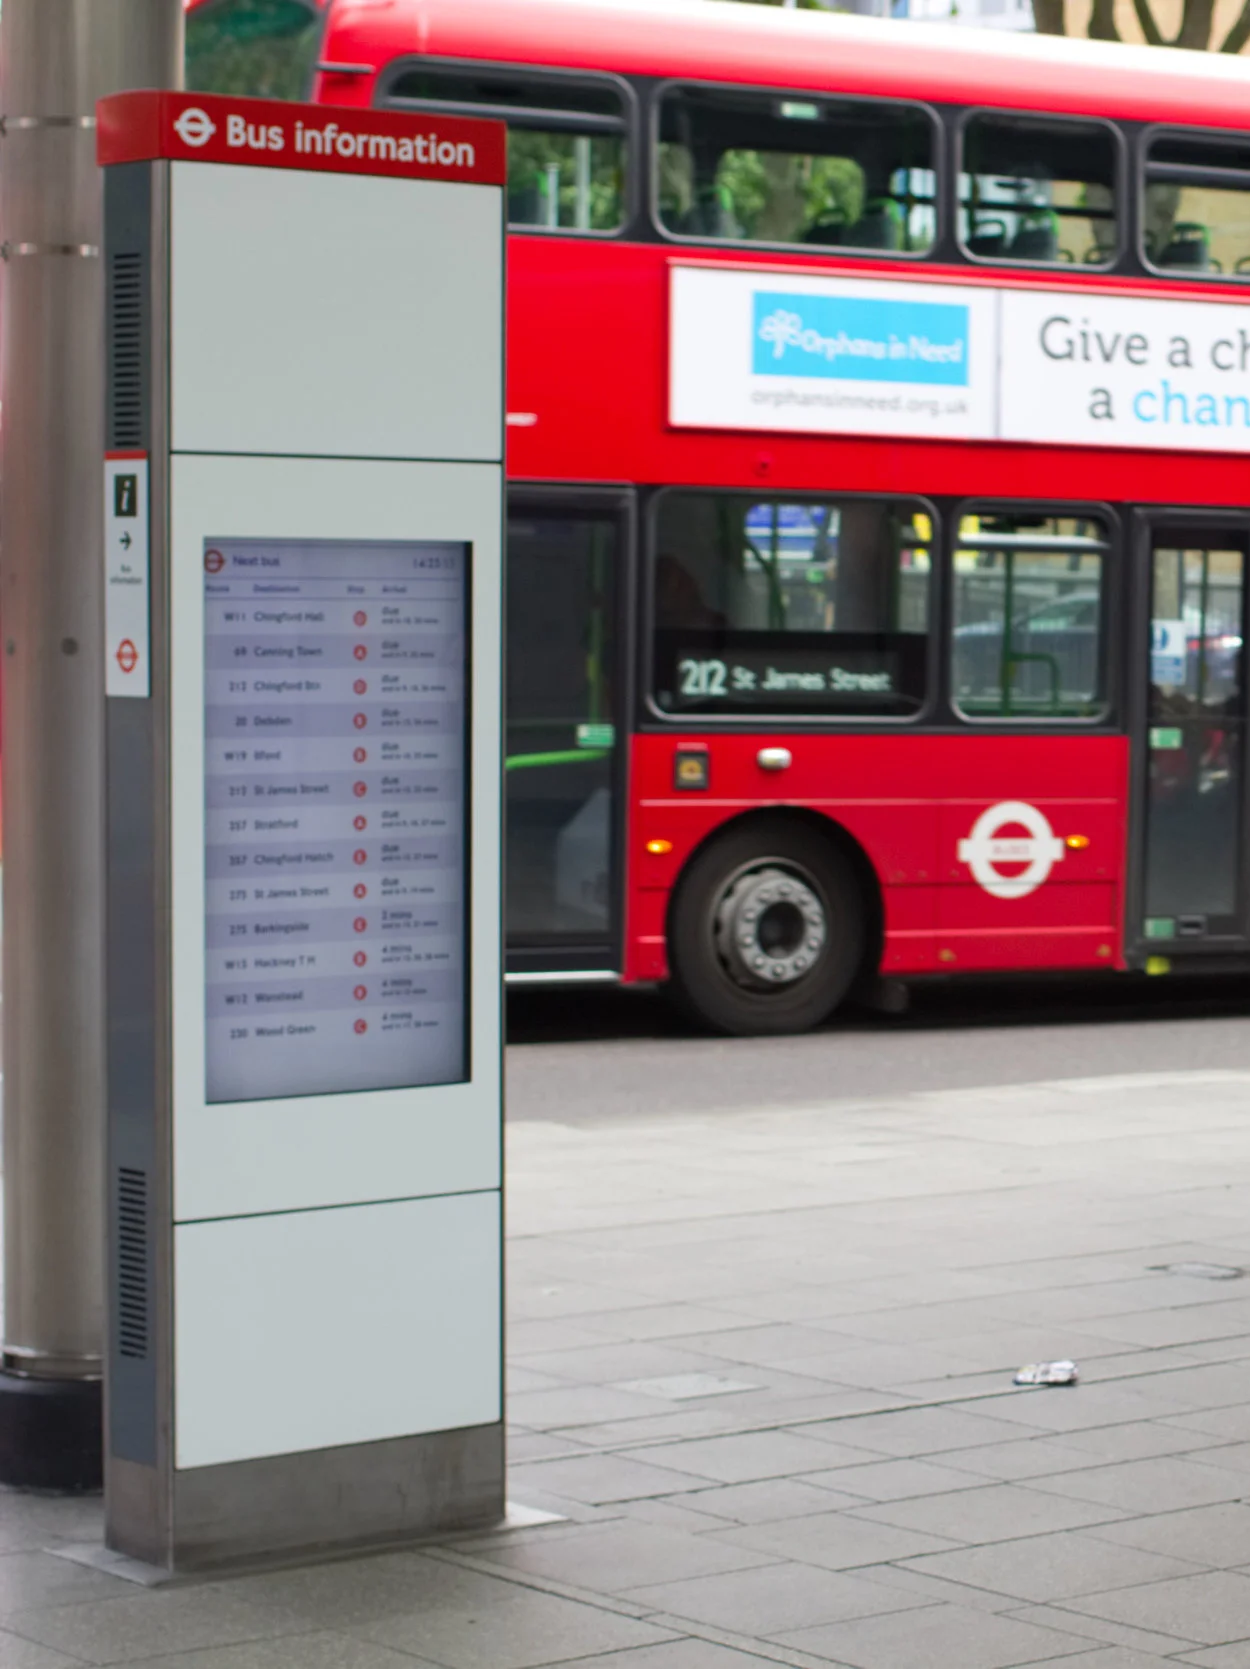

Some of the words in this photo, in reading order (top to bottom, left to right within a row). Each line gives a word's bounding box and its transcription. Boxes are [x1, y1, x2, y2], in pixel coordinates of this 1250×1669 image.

[227, 115, 284, 150] Bus
[296, 122, 474, 166] information
[621, 161, 705, 193] Trains
[800, 329, 886, 361] Orphans
[889, 334, 906, 360] in
[908, 335, 963, 363] Need
[1039, 316, 1149, 365] Give
[1167, 335, 1193, 368] a
[1088, 386, 1115, 420] a
[233, 556, 258, 567] Next
[679, 659, 728, 695] 212
[761, 667, 826, 691] James
[829, 667, 891, 691] Street
